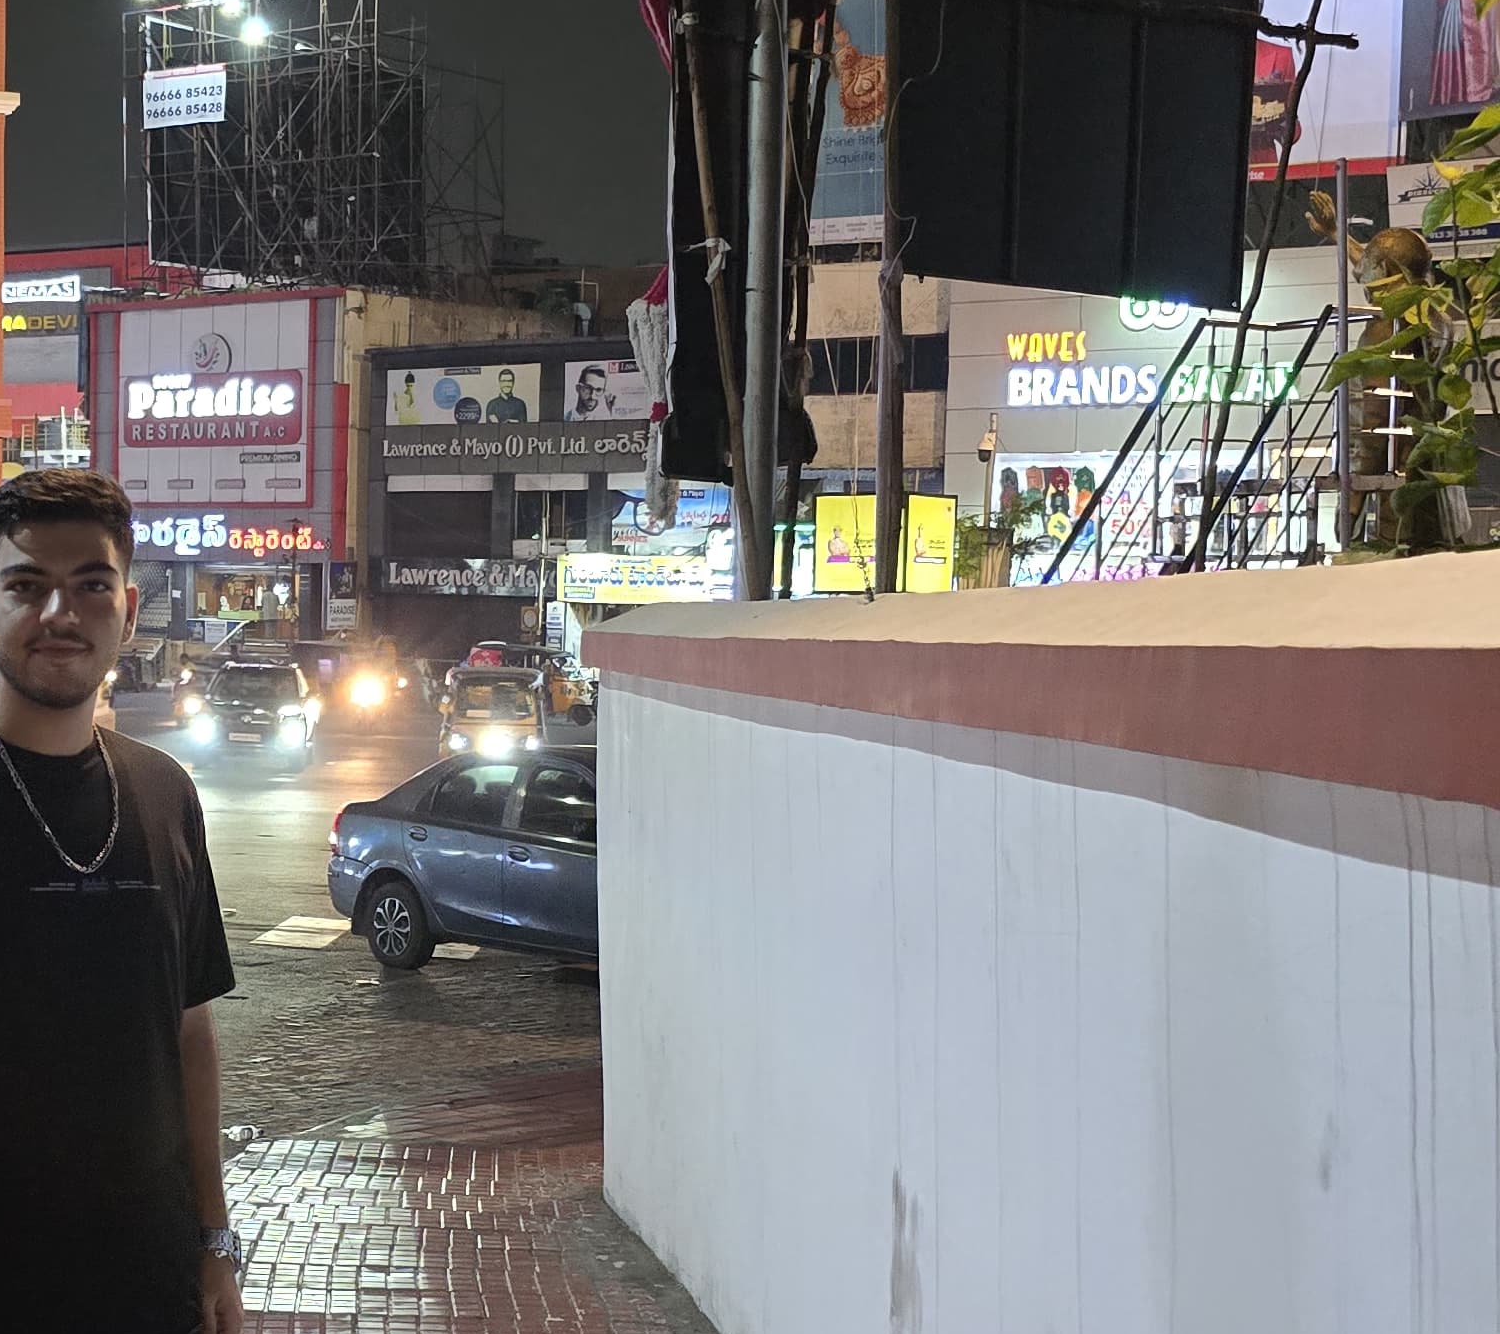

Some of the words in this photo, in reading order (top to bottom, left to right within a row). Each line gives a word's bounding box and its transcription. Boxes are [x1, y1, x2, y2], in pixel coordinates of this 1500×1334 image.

[146, 89, 182, 103] 96666
[186, 85, 223, 99] 85423
[146, 106, 182, 120] 96666
[1007, 331, 1087, 362] WAVES
[1007, 365, 1157, 406] BRANDS
[128, 378, 295, 419] Paradise
[132, 421, 260, 441] RESTAURANT
[383, 439, 446, 457] Lawrence
[449, 438, 461, 456] &
[464, 438, 503, 460] Mayo
[388, 562, 485, 587] Lawrence
[489, 563, 505, 587] &
